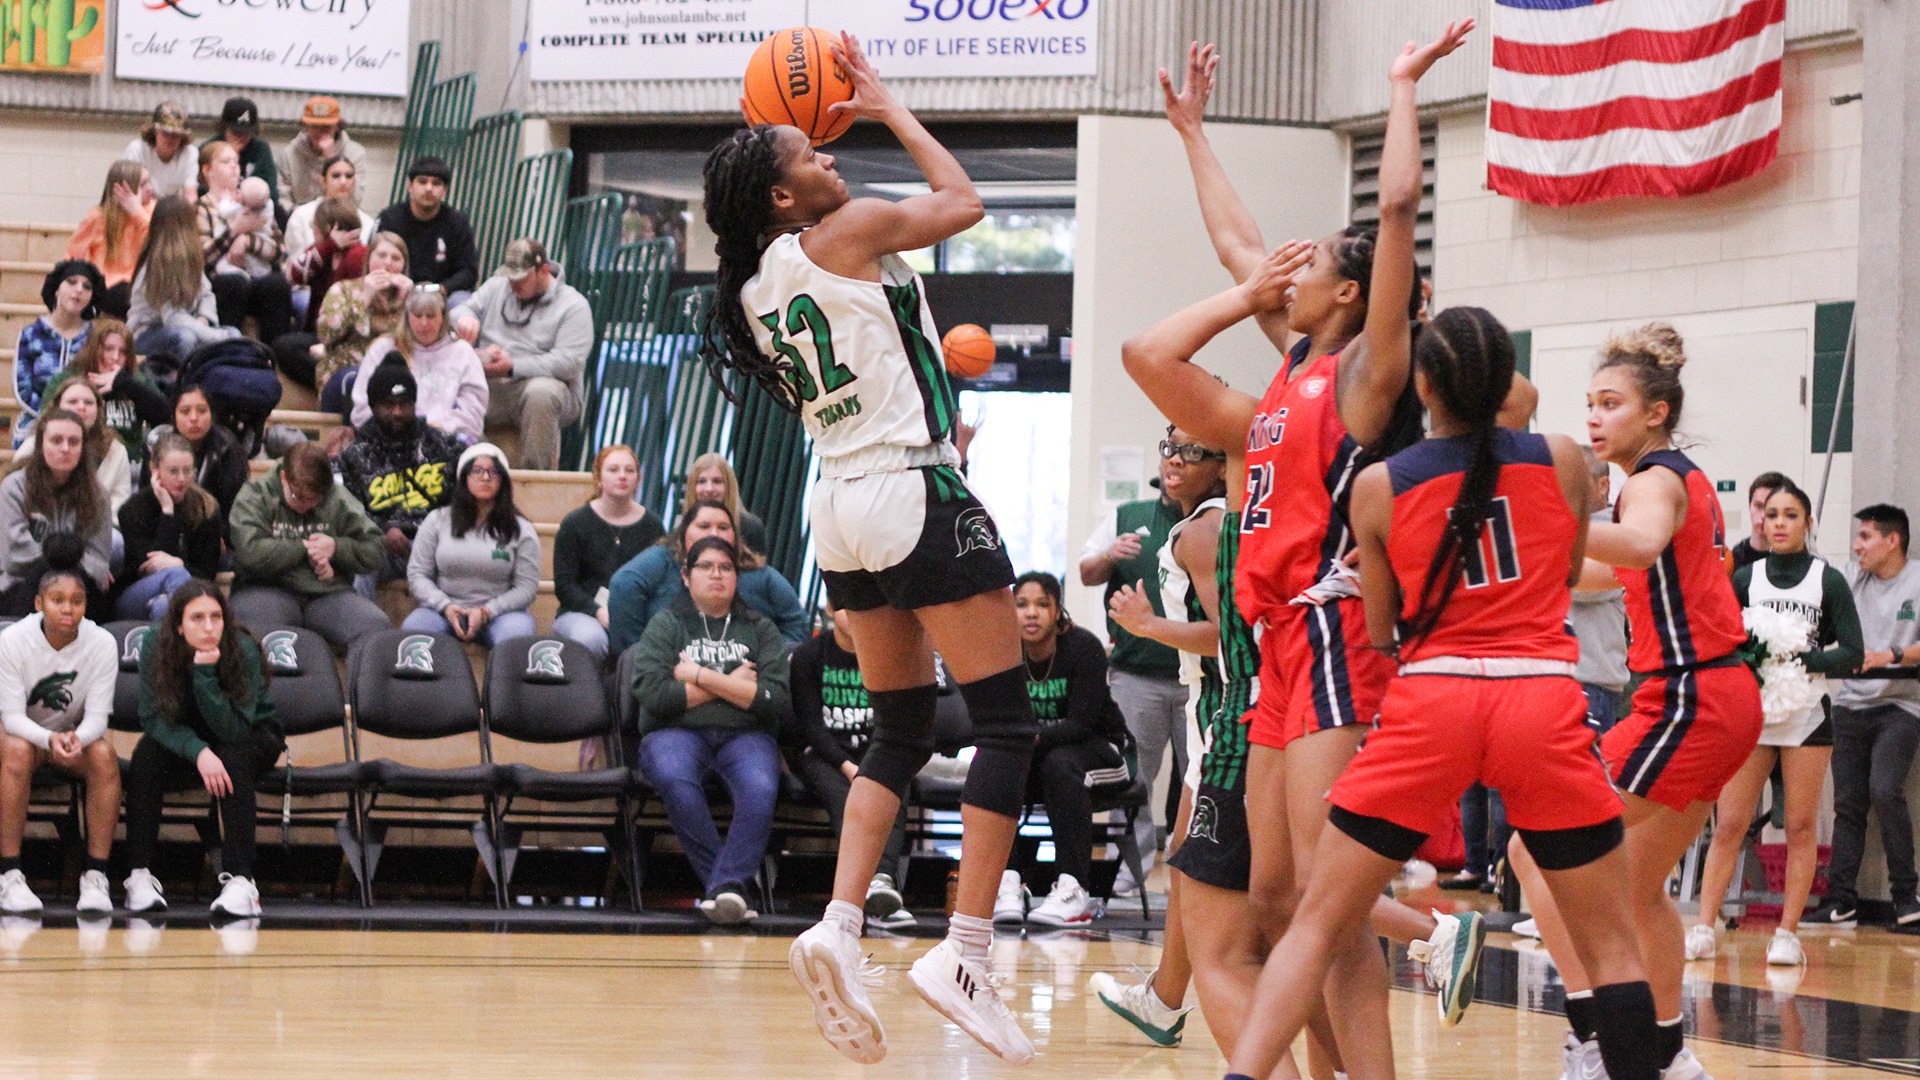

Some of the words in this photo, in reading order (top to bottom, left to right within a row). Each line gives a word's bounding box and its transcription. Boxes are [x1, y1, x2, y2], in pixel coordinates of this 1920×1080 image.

[540, 33, 630, 47] COMPLETE
[639, 32, 687, 46] TEAM
[904, 38, 929, 56] OF
[936, 37, 980, 55] LIFE
[986, 36, 1087, 55] SERVICES
[190, 36, 277, 61] Because
[295, 42, 340, 69] Love
[785, 29, 811, 99] Wilson
[822, 665, 863, 686] MOU
[1026, 678, 1067, 699] OUNT
